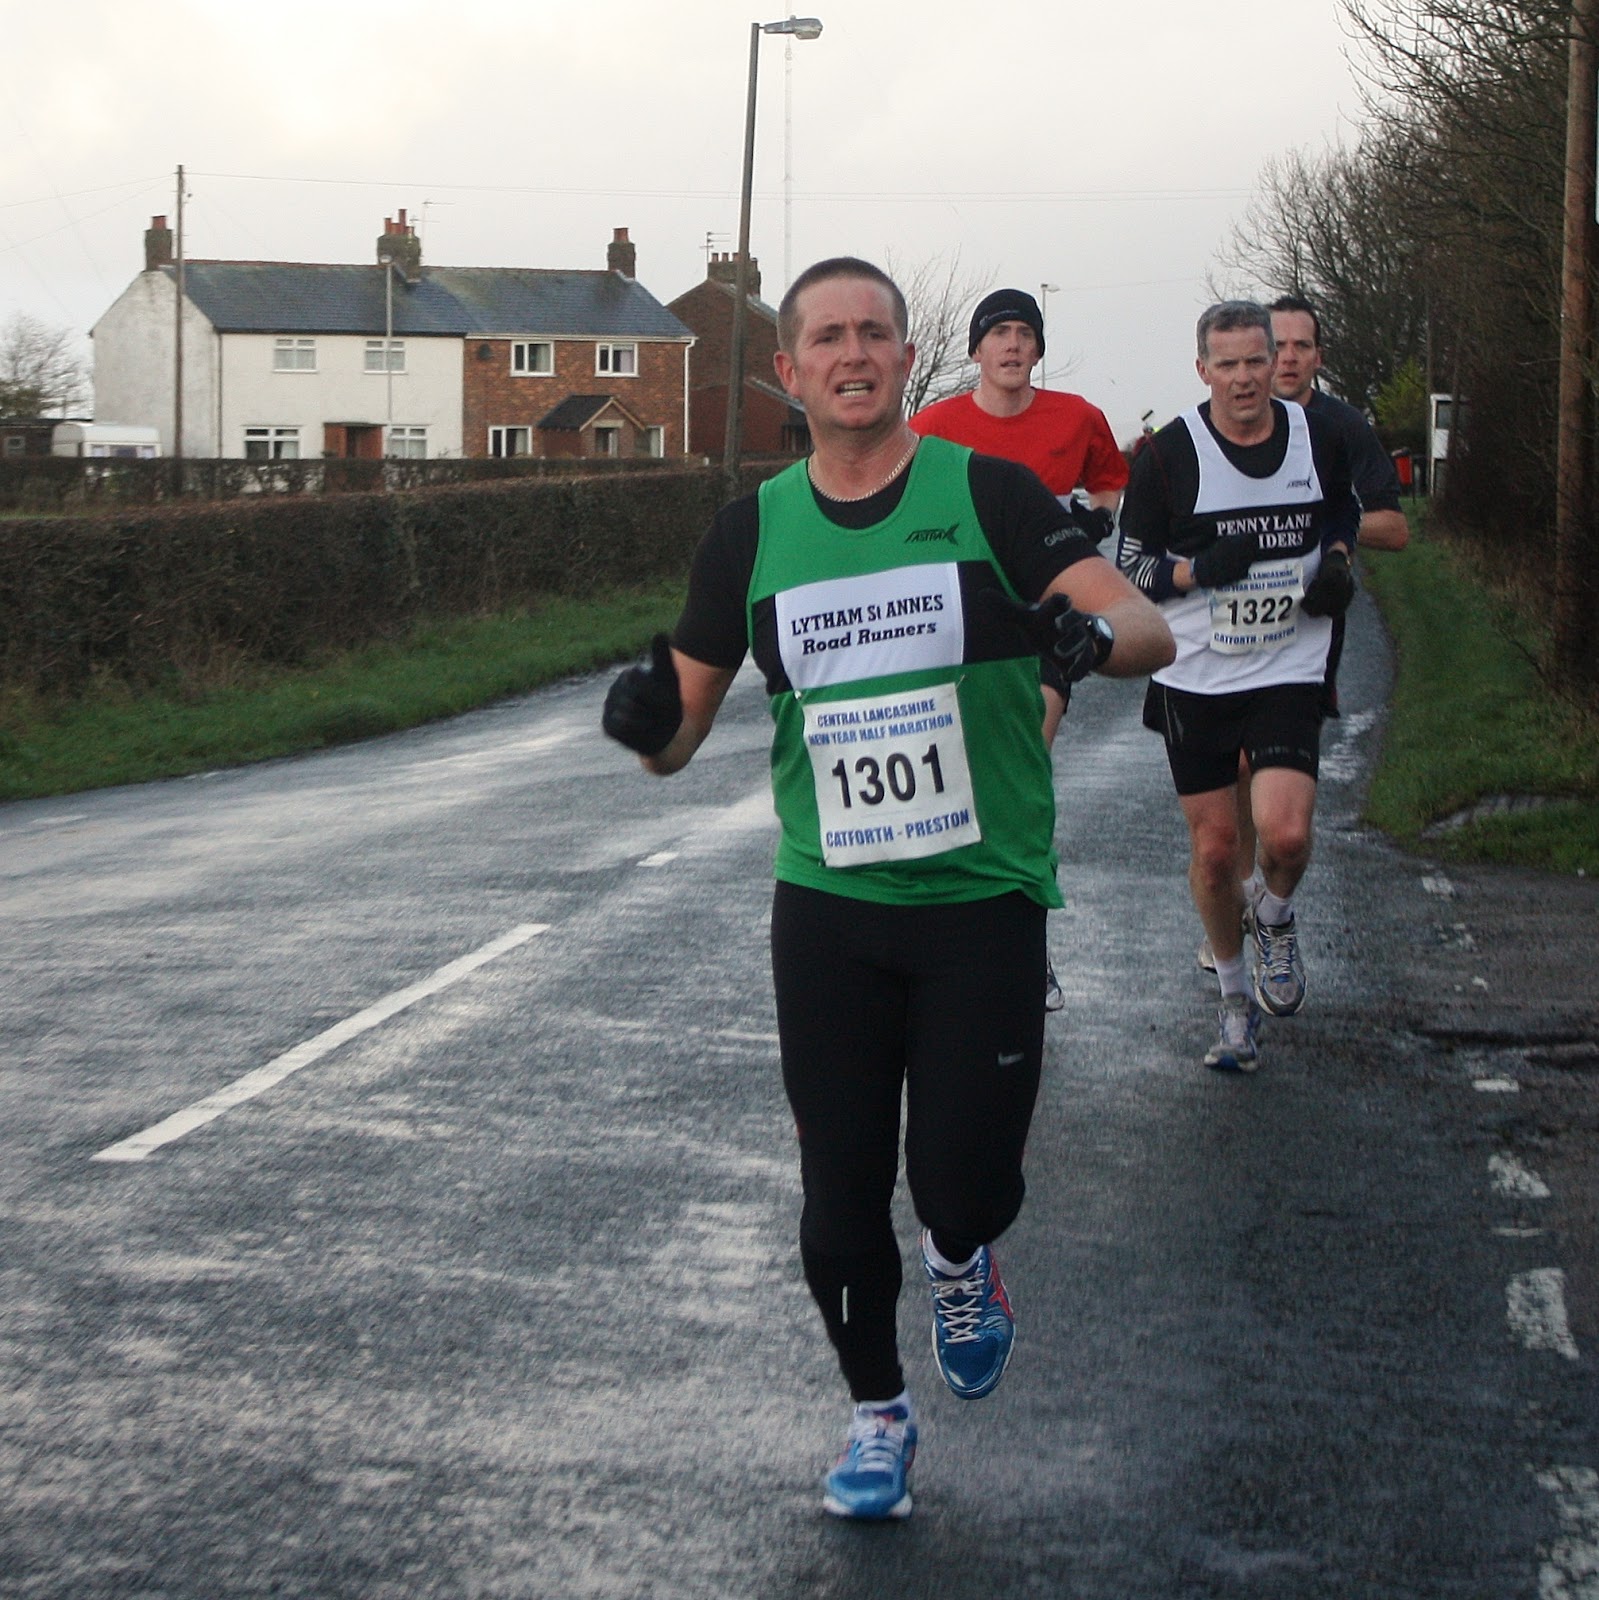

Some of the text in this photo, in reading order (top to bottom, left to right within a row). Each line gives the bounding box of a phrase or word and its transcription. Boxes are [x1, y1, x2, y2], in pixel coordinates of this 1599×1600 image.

[1216, 513, 1312, 536] PENNY LANE
[1258, 530, 1304, 549] IDERS
[791, 607, 863, 636] LYTHAM
[885, 594, 944, 618] ANNES
[1227, 595, 1293, 625] 1322
[802, 622, 937, 655] Road Runners
[808, 713, 954, 746] NEW YEAR HALF MARATHON
[817, 698, 936, 728] CENTRAL LANCASHIRE
[832, 743, 945, 808] 1301
[826, 825, 895, 848] CATFORTH
[904, 808, 970, 839] PRESTON
